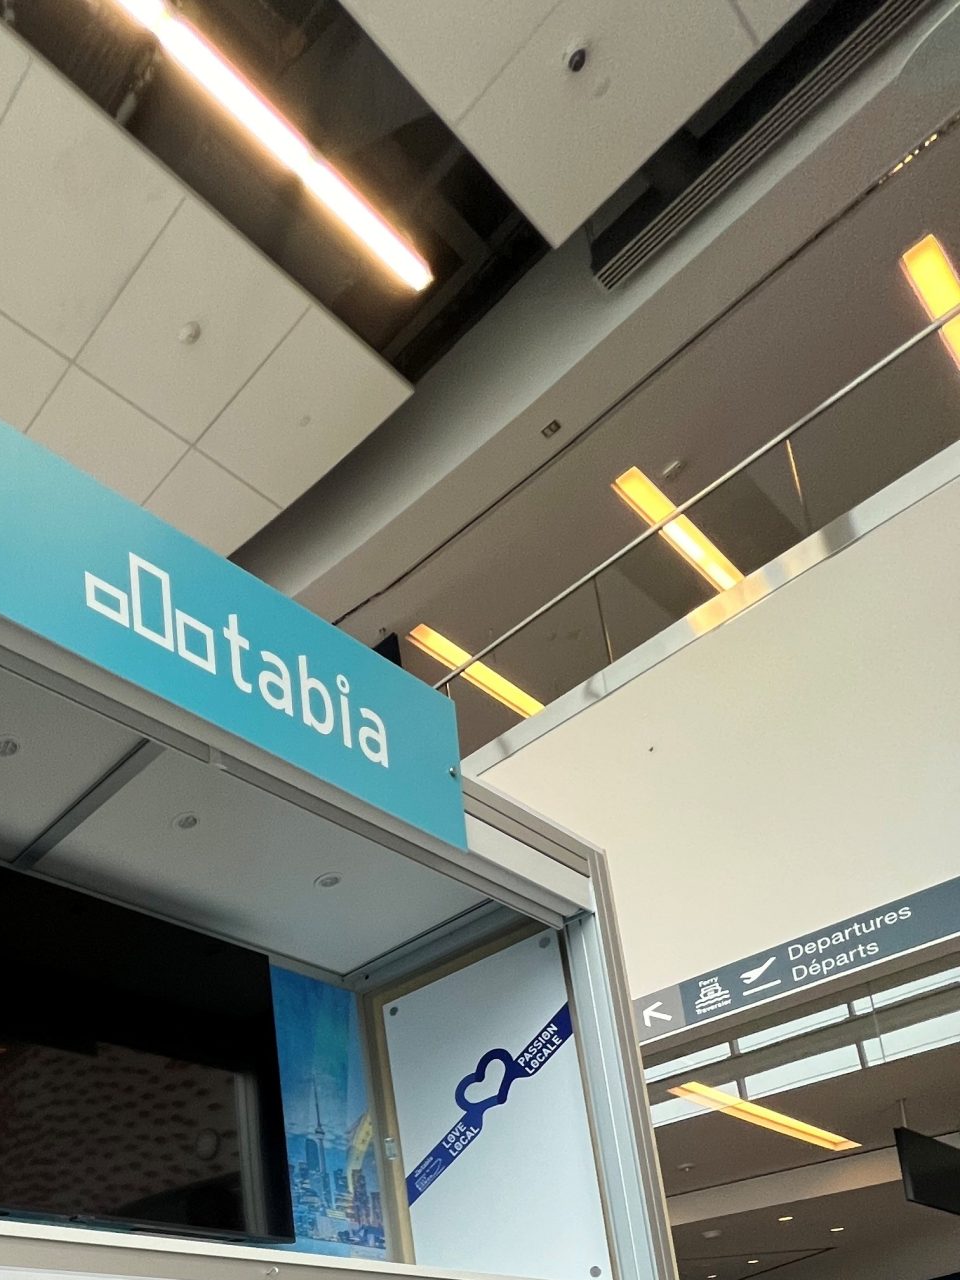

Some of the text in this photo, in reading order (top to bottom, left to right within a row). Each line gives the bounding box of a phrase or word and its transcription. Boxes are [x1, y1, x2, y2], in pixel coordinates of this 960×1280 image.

[223, 613, 389, 768] tabia
[787, 904, 912, 961] Departures
[698, 976, 718, 987] Ferry
[792, 940, 880, 982] Départs
[517, 1023, 558, 1067] PASSION
[525, 1034, 562, 1075] LOCALE
[442, 1121, 467, 1149] LOVE
[449, 1126, 480, 1157] LOCAL
